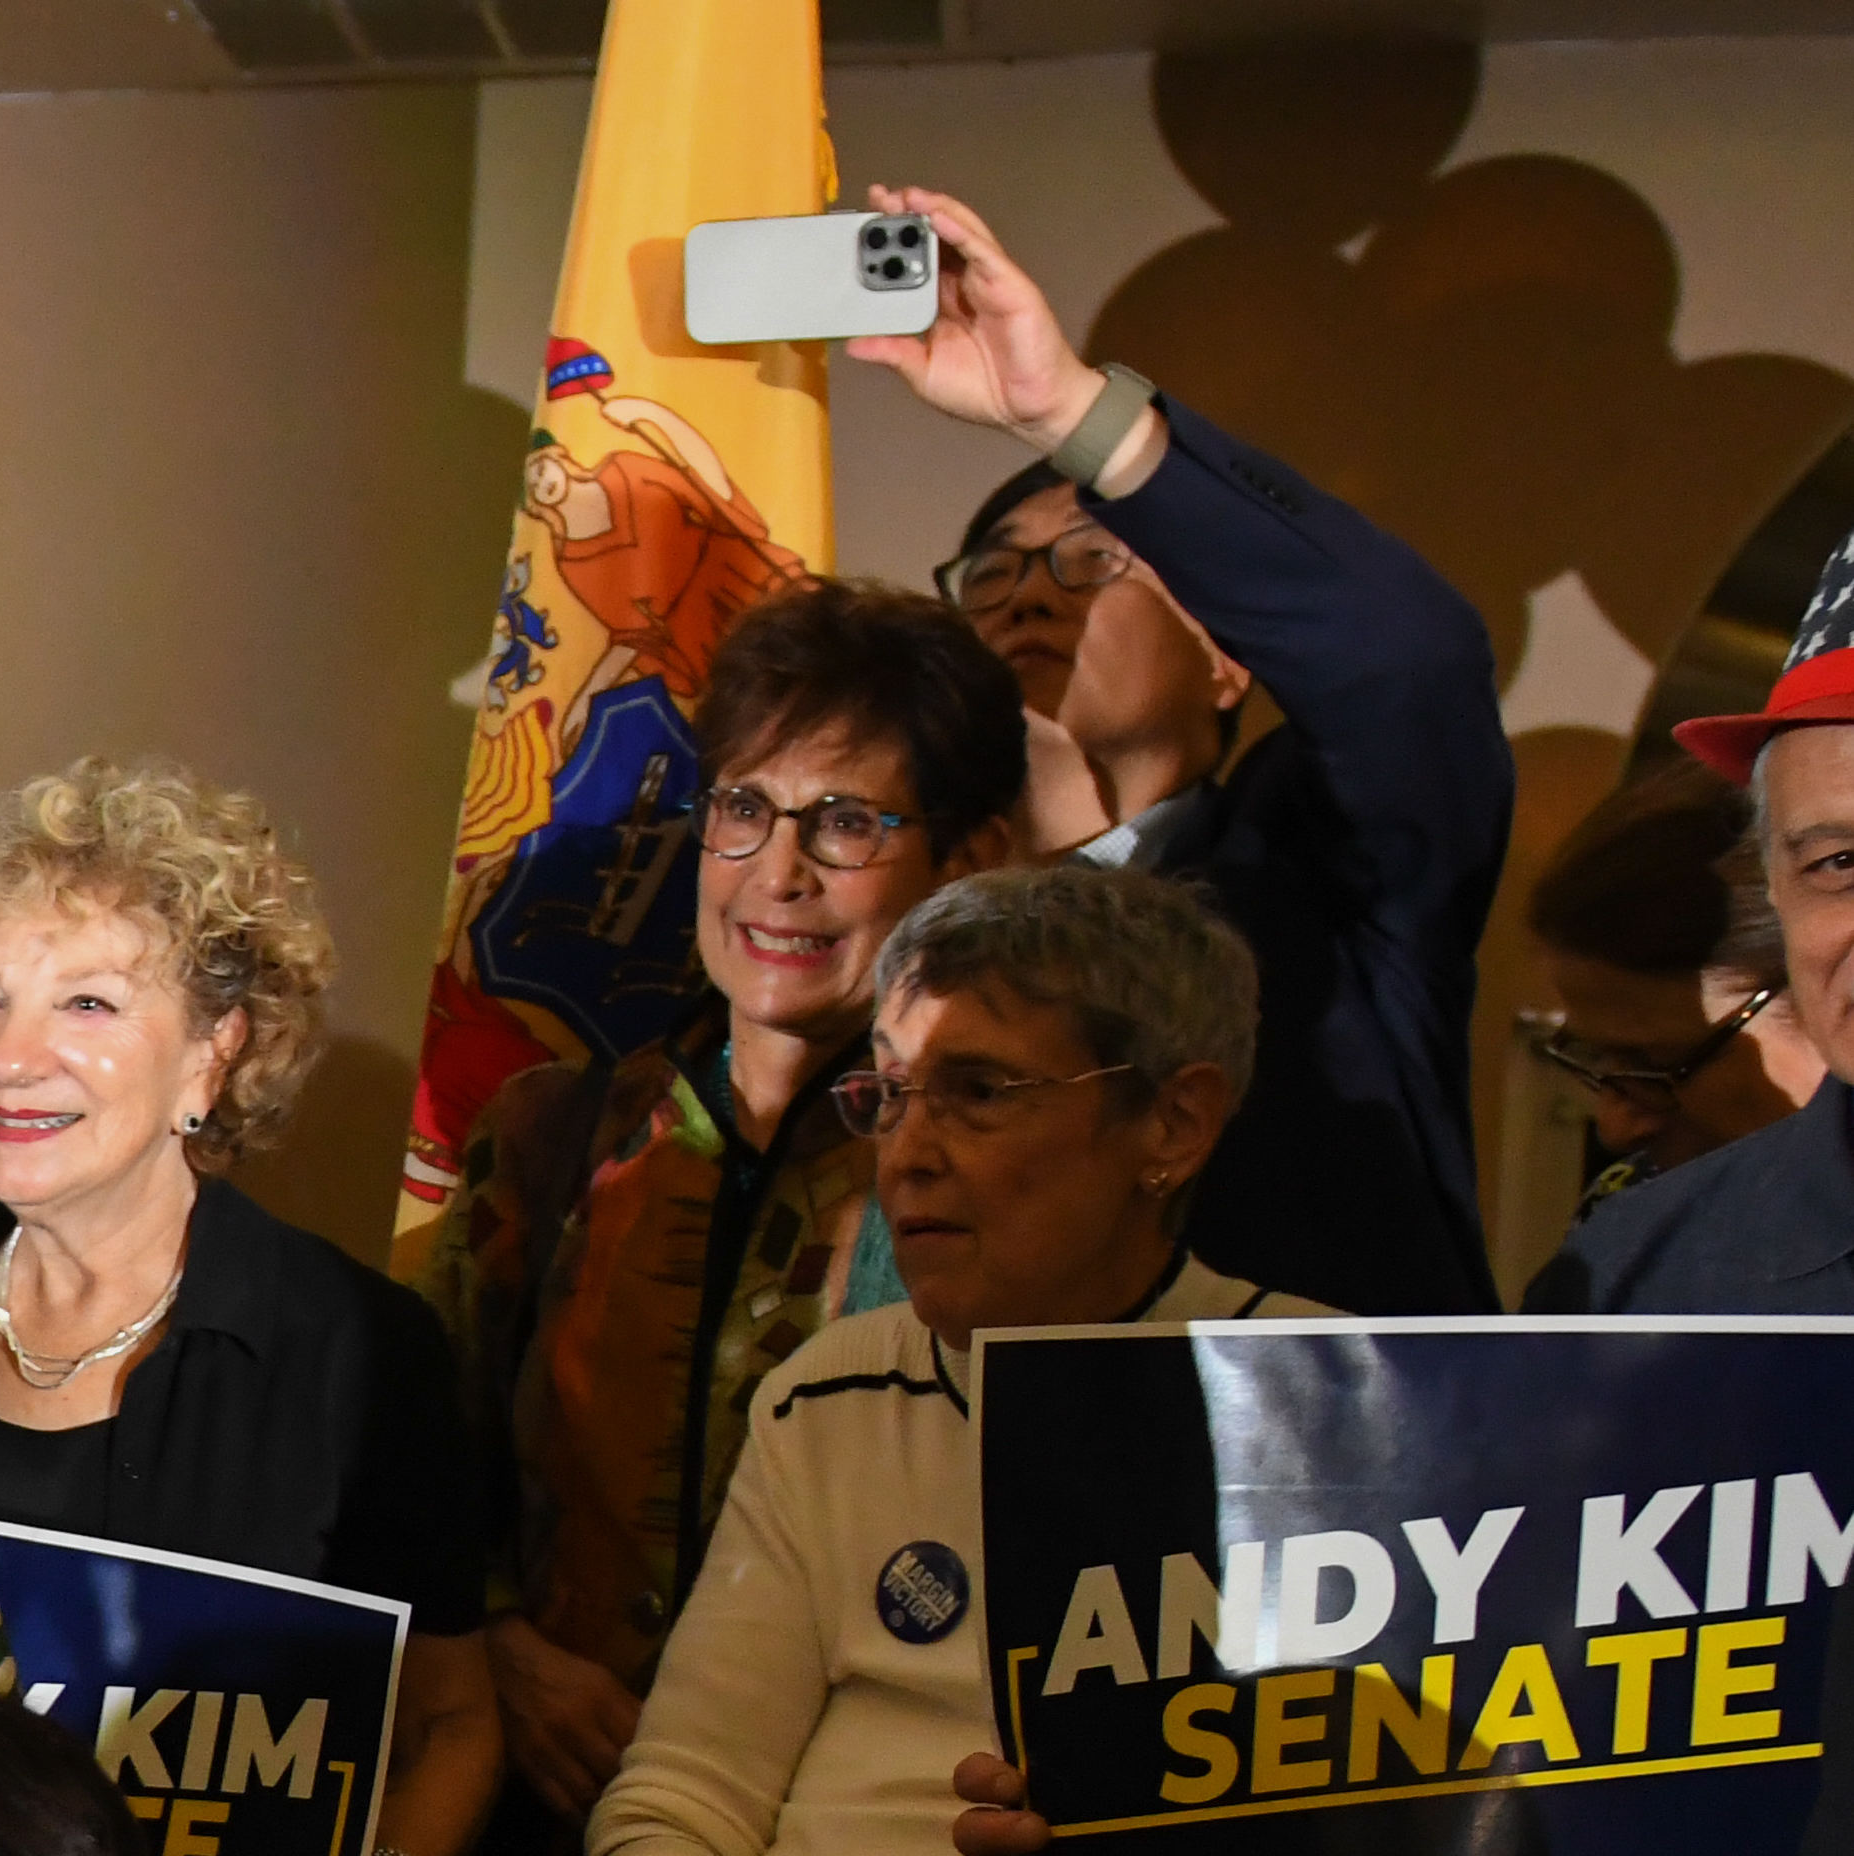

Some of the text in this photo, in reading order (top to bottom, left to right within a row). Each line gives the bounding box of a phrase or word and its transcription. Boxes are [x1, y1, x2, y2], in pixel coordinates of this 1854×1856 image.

[1041, 1471, 1854, 1696] ANDY KIM
[95, 1685, 329, 1799] KIM
[1158, 1616, 1787, 1805] SENATE
